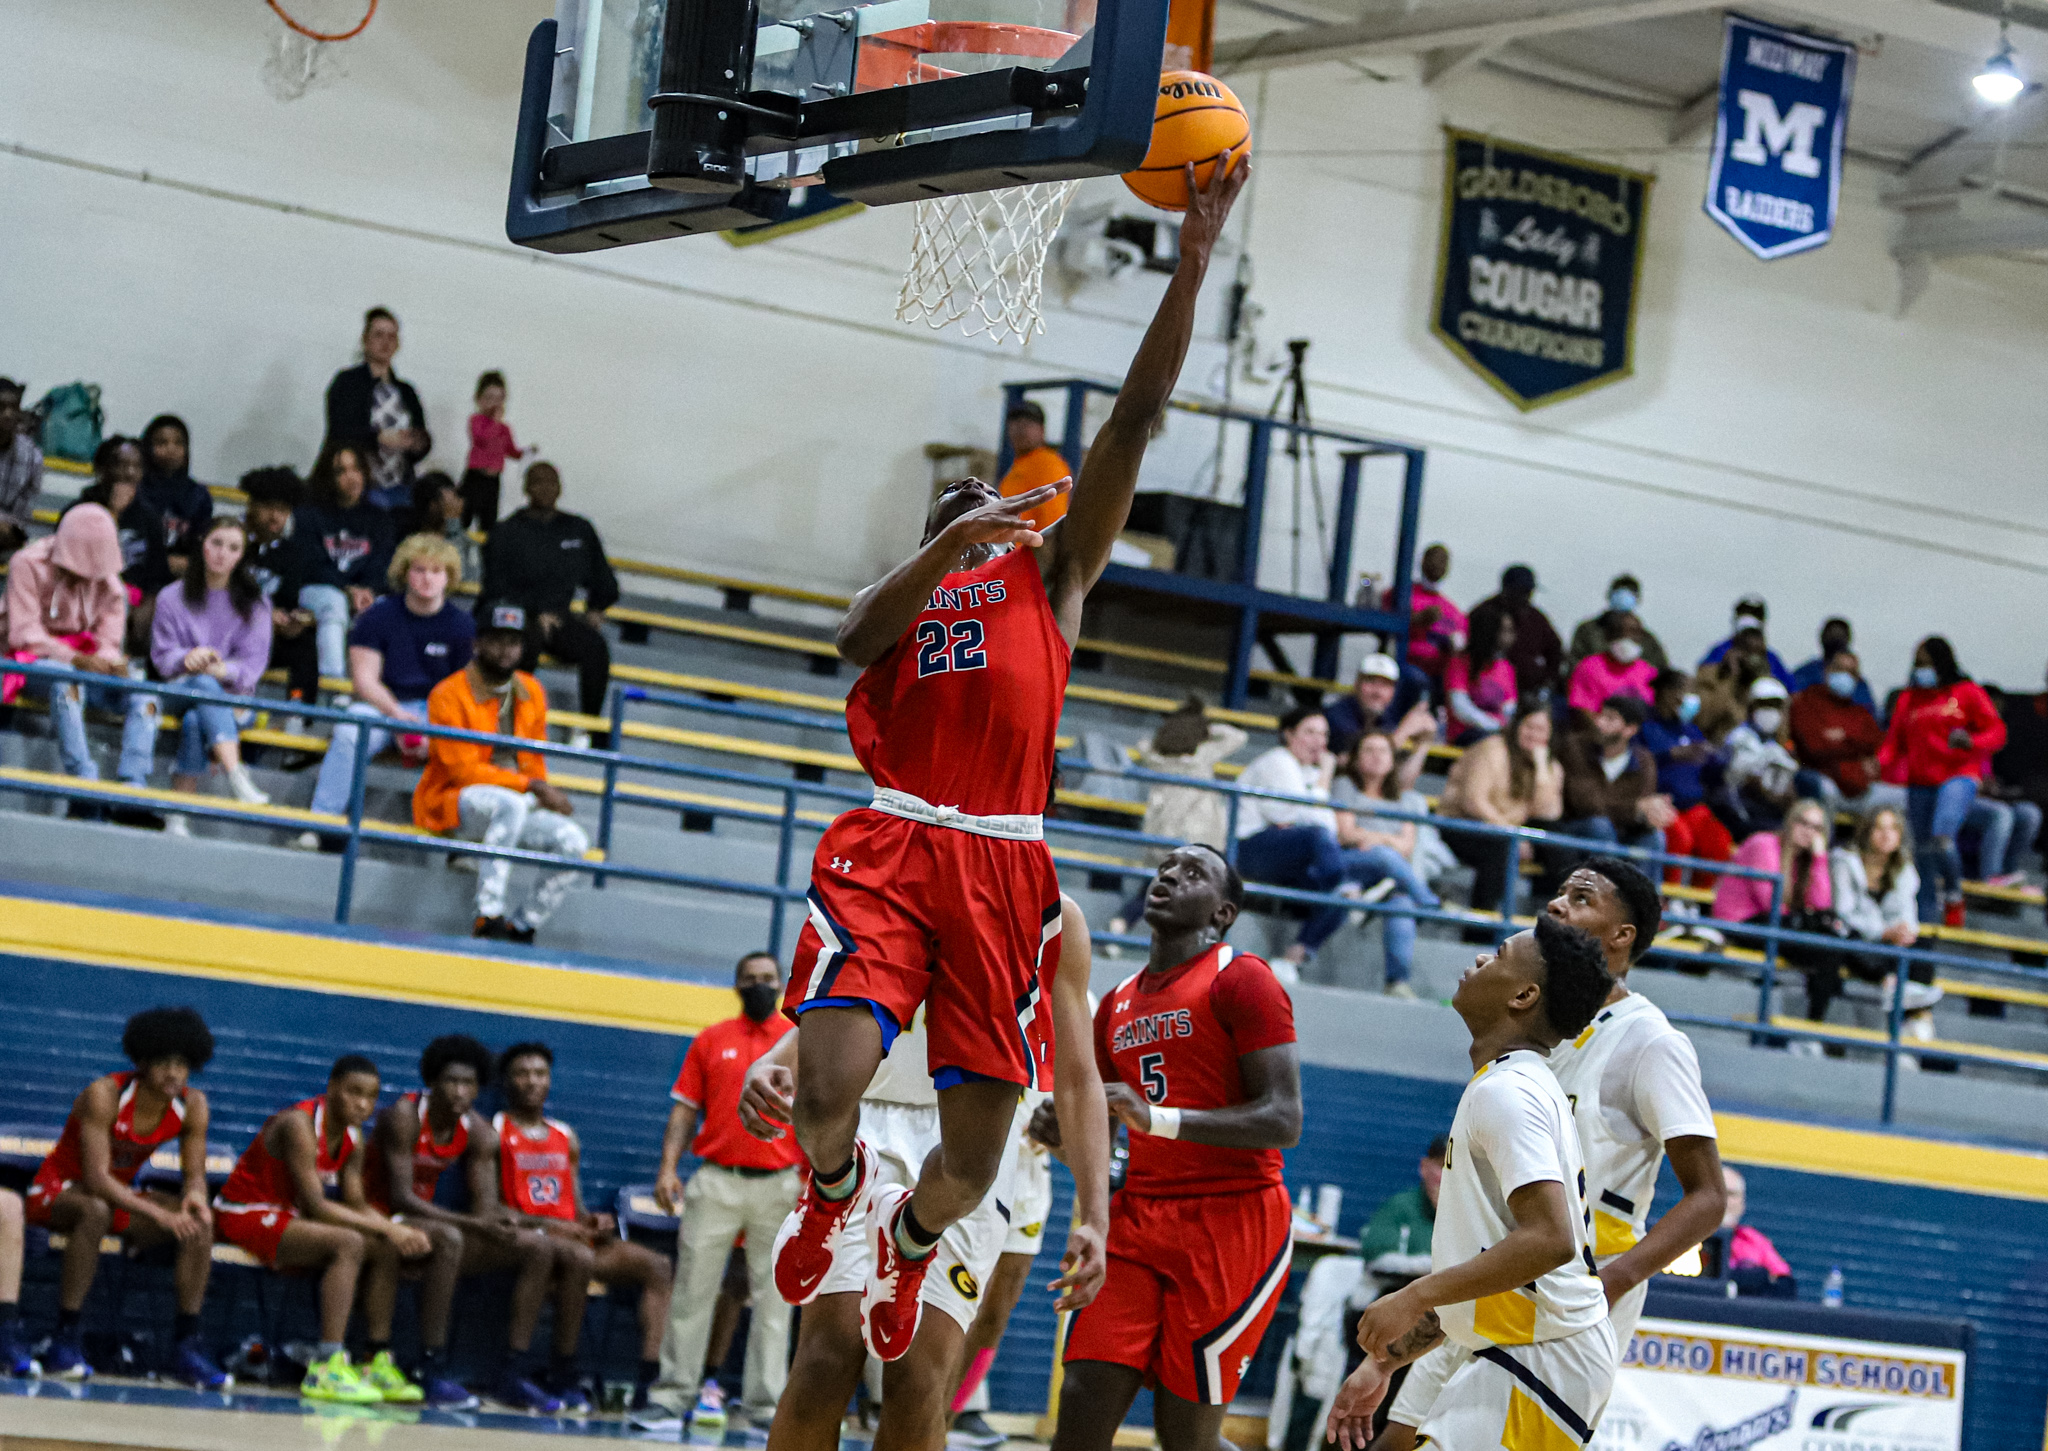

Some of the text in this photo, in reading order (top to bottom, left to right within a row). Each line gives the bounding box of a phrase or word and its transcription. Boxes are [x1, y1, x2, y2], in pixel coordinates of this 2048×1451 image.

[1730, 88, 1827, 178] M
[1725, 185, 1815, 234] RAIDERS
[1502, 215, 1577, 267] Lady
[1469, 254, 1603, 330] COUGAR
[922, 579, 1007, 612] INTS
[917, 619, 987, 679] 22
[1112, 1008, 1193, 1054] SAINTS
[1139, 1052, 1168, 1105] 5
[1725, 1347, 1806, 1382] HIGH
[1817, 1357, 1950, 1396] SCHOOL
